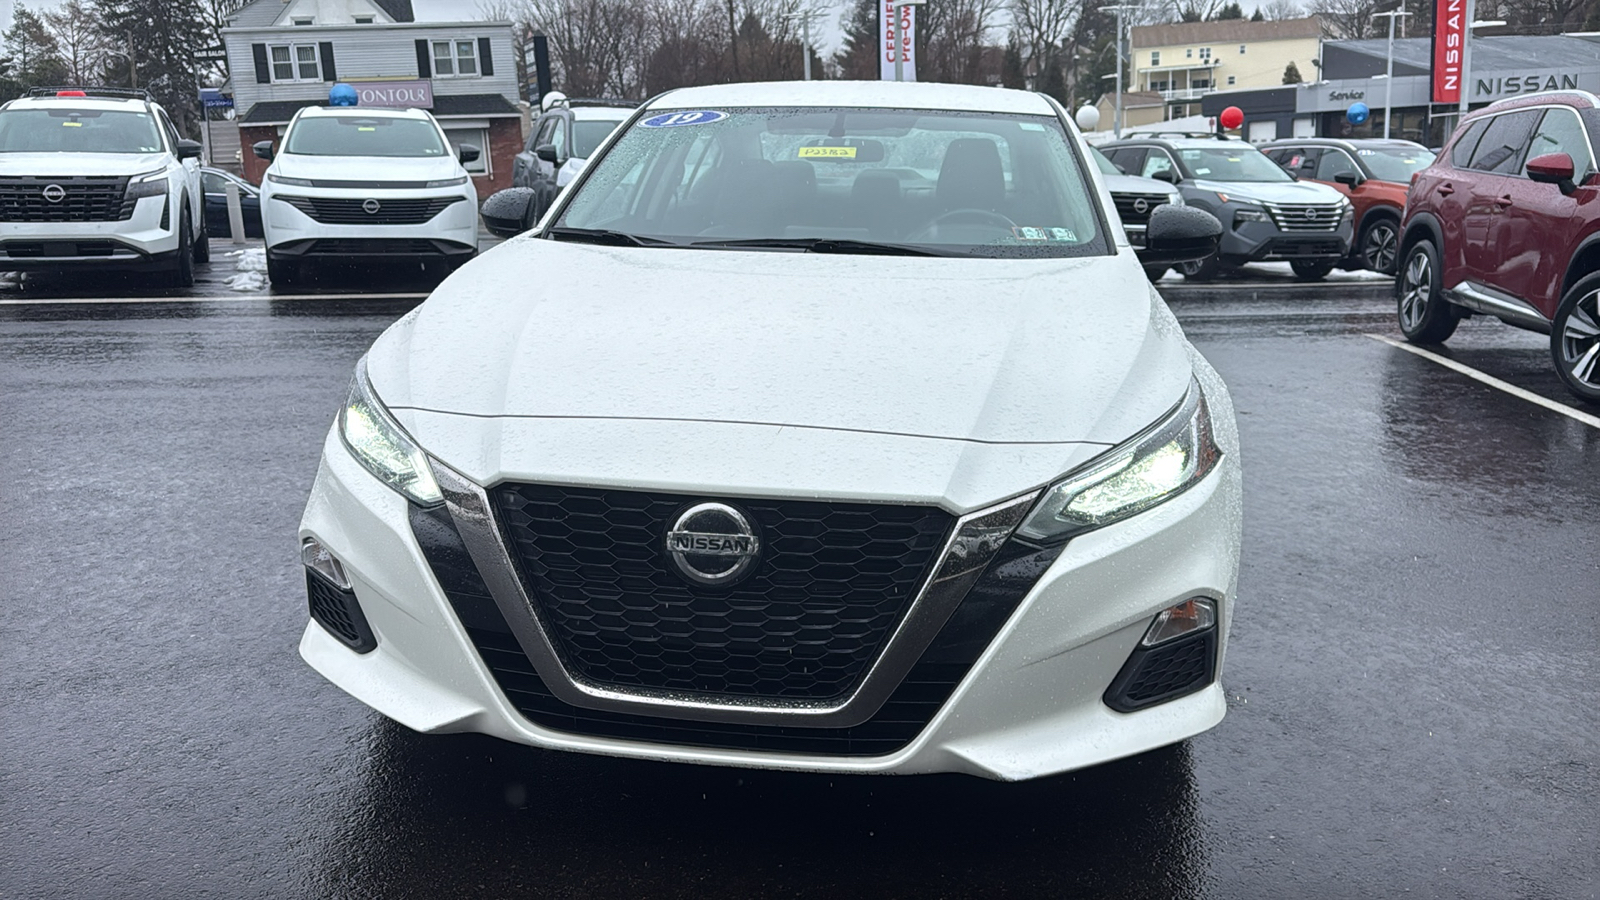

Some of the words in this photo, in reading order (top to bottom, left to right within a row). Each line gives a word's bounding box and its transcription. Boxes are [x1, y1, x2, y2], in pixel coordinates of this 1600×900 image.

[1444, 0, 1461, 90] NISSAN
[1476, 74, 1578, 95] NISSAN
[356, 88, 426, 103] ONTOUR
[1329, 90, 1365, 101] Service
[660, 112, 704, 126] 19
[676, 537, 749, 552] NISSAN
